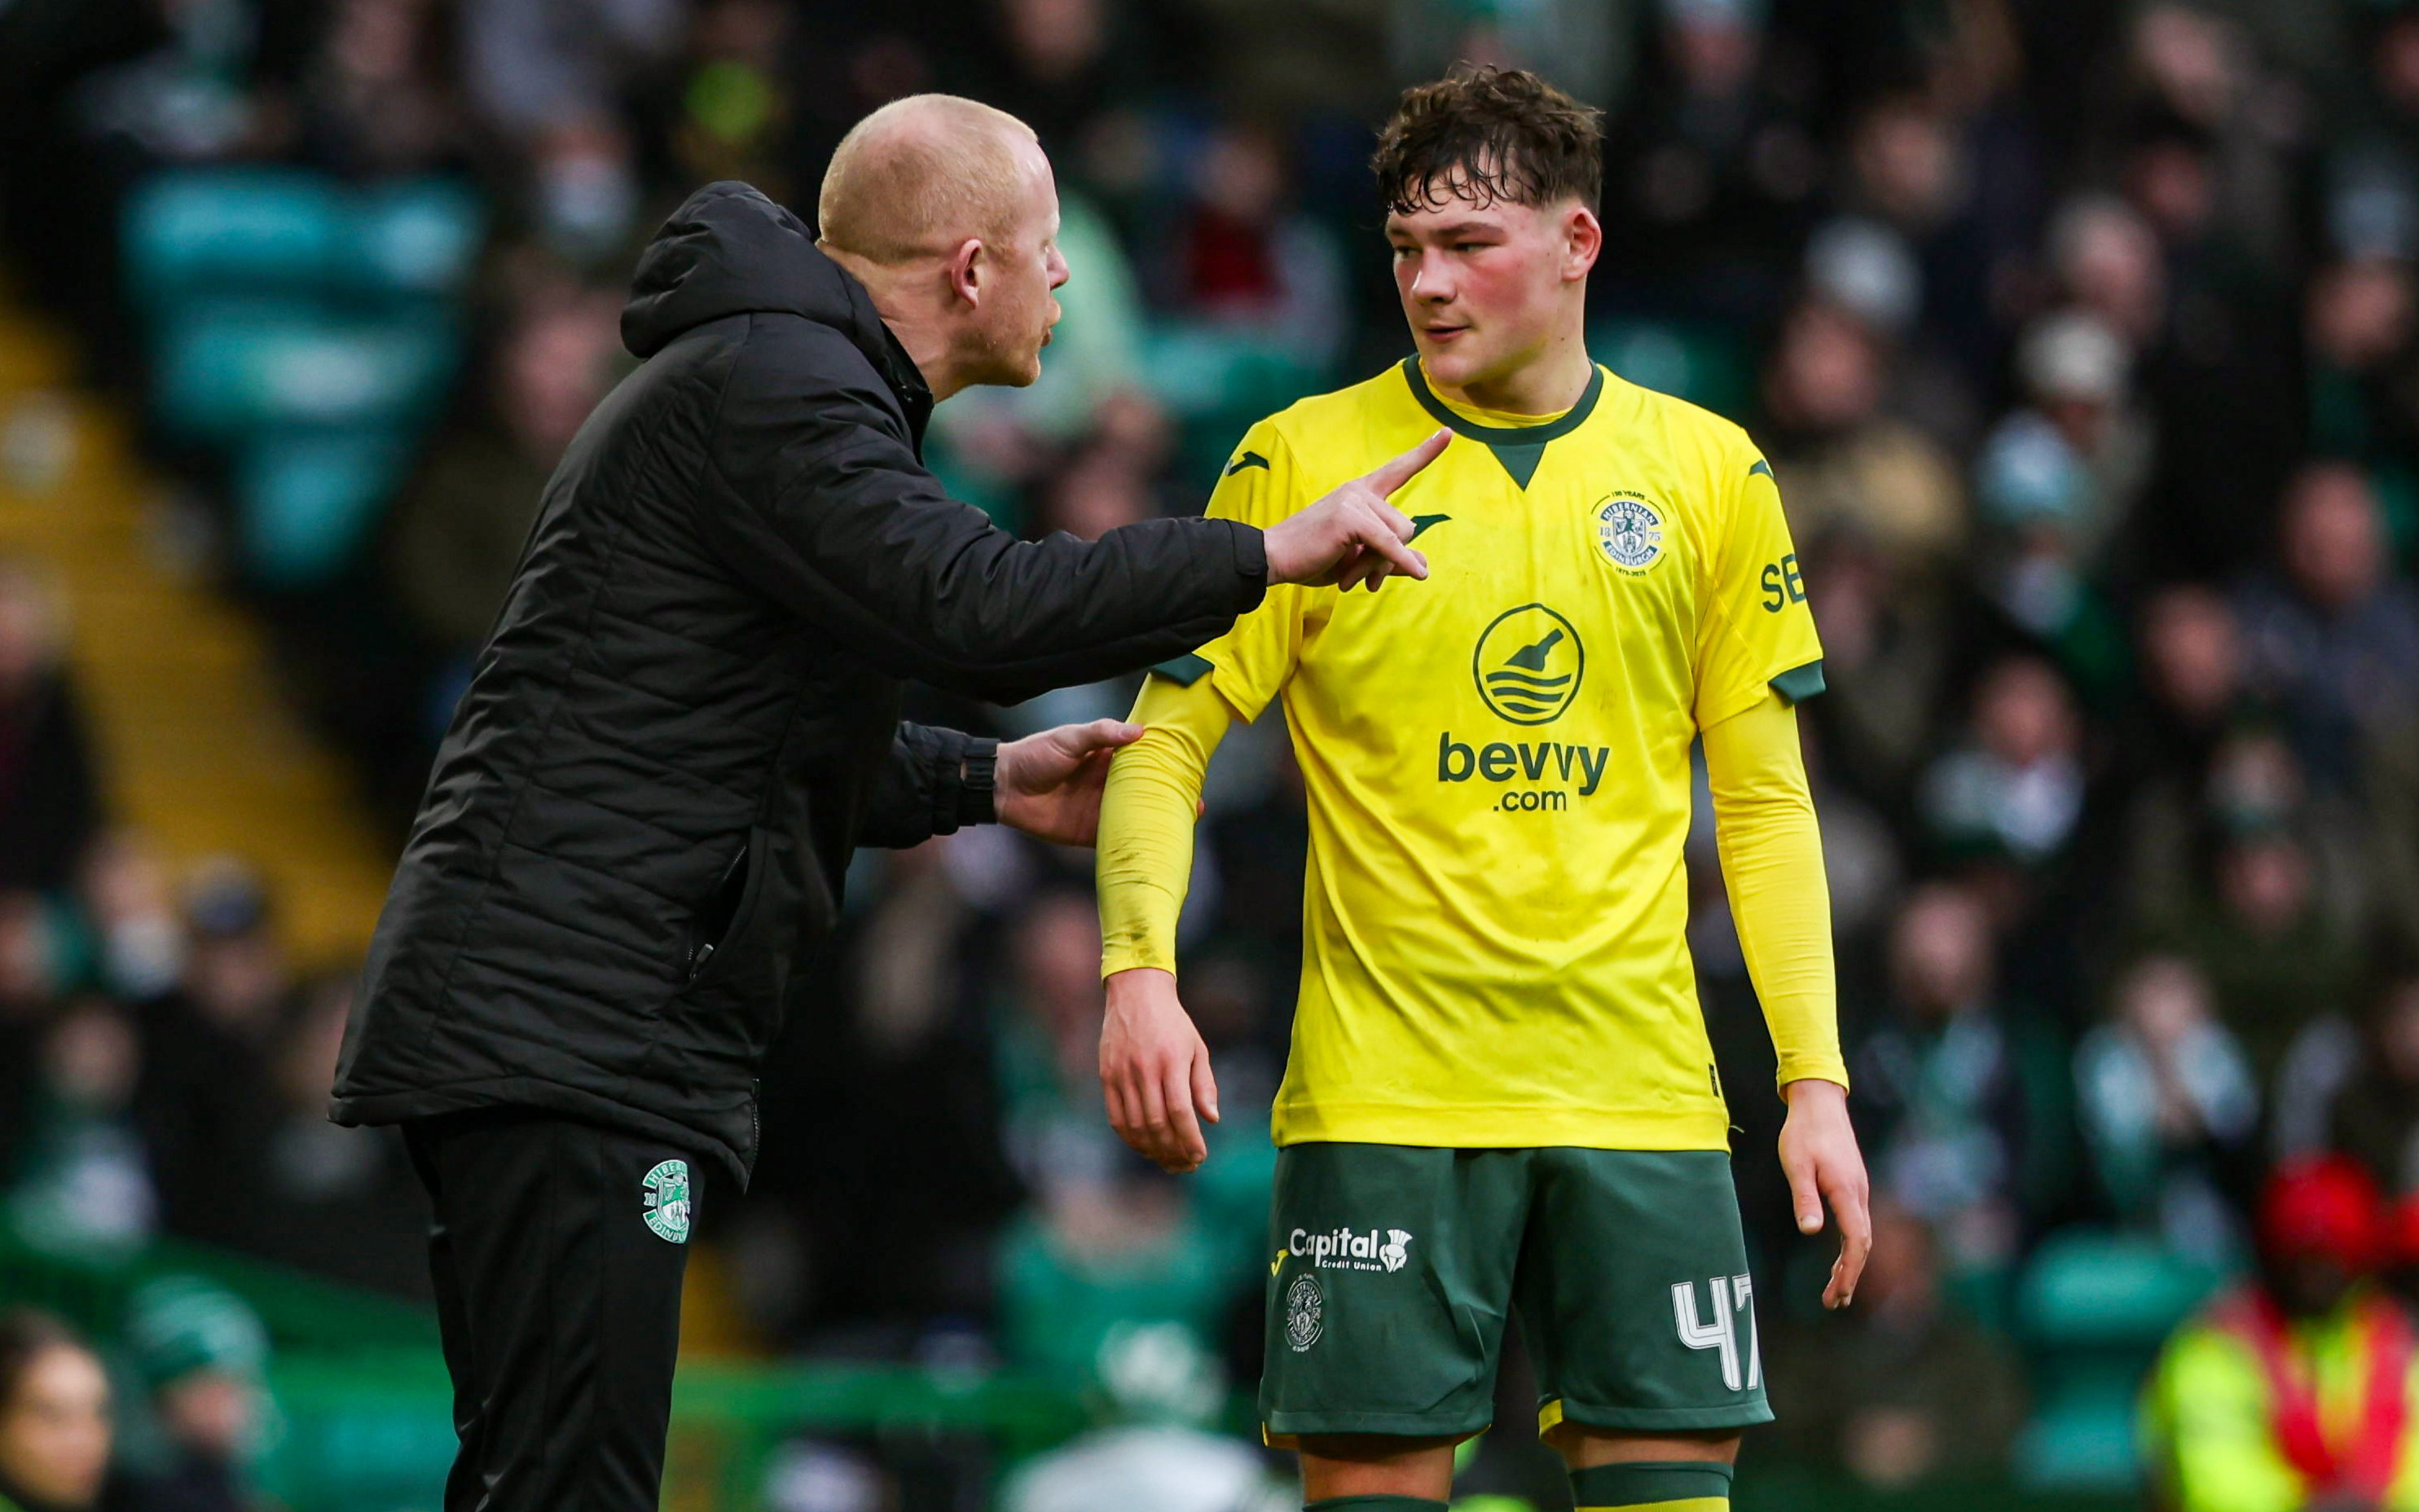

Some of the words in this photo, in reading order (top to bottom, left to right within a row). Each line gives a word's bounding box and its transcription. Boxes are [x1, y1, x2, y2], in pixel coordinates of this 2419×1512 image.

[1603, 502, 1657, 525] HIBERNIAN
[1648, 531, 1660, 542] 75
[1606, 546, 1656, 566] EDINBURGH
[1438, 731, 1610, 796] bevvy
[1493, 790, 1567, 812] .com
[1290, 1227, 1379, 1268] Capital
[1322, 1259, 1350, 1269] Credit
[1353, 1261, 1382, 1271] Union
[1671, 1273, 1759, 1391] 47
